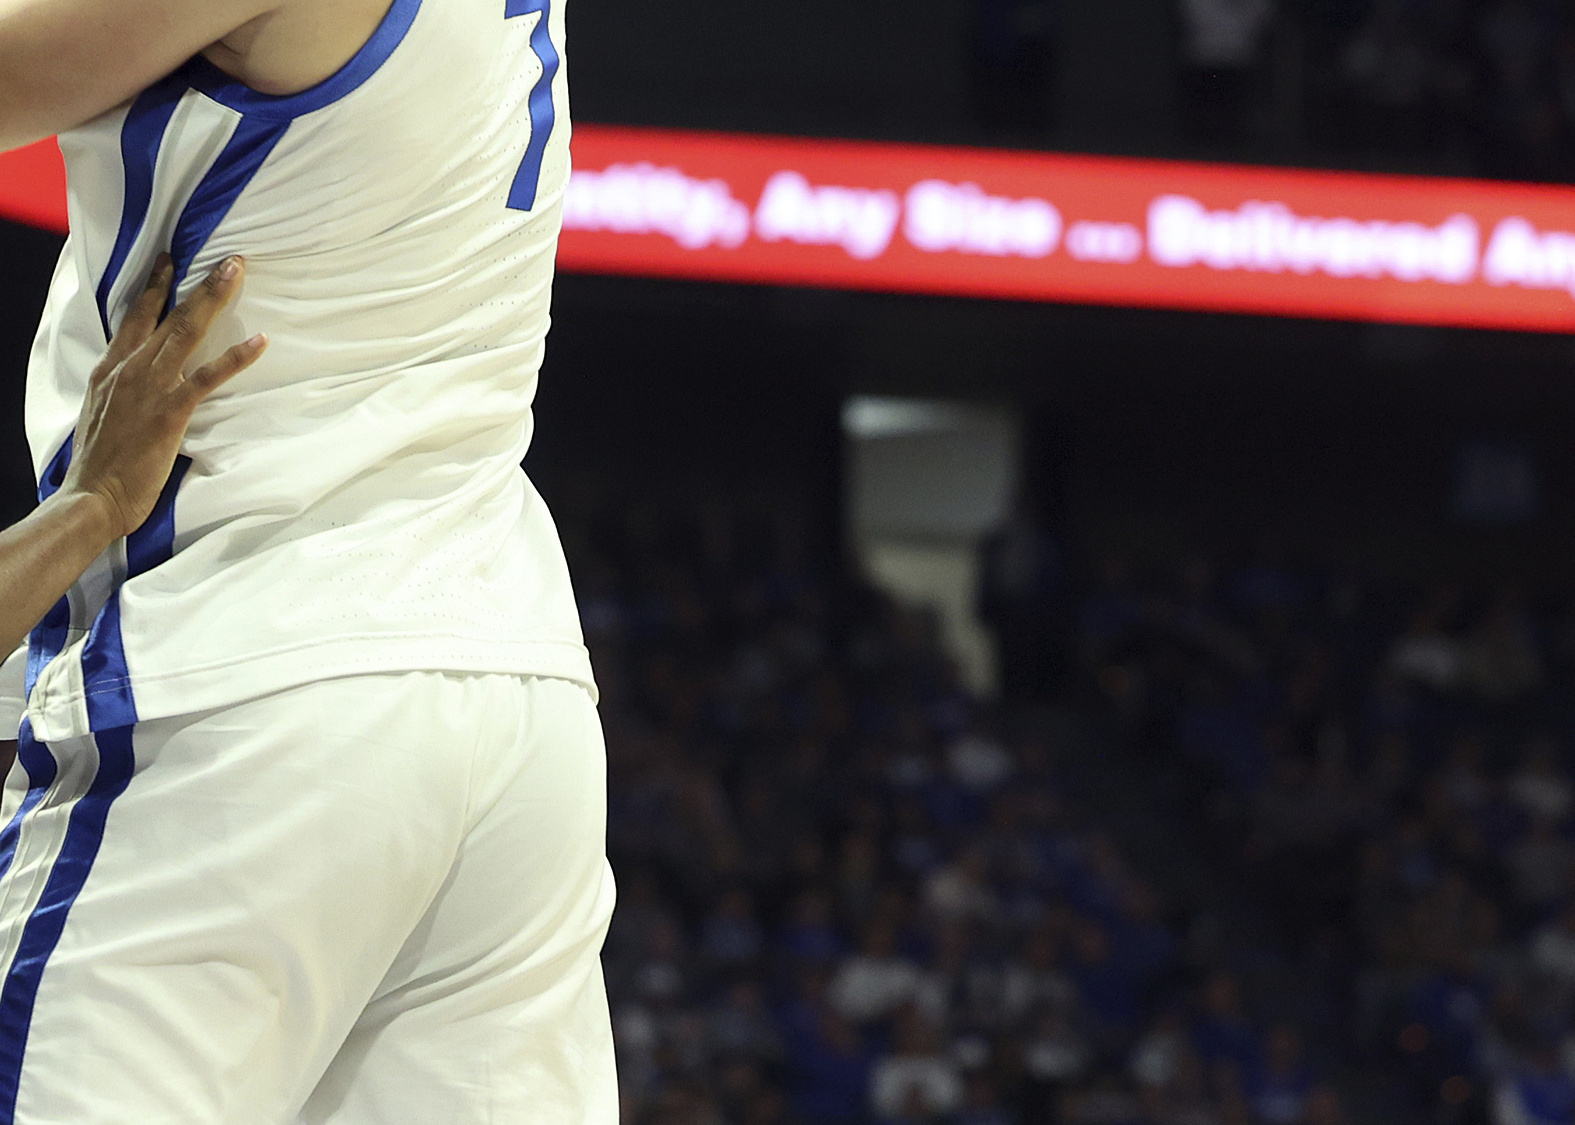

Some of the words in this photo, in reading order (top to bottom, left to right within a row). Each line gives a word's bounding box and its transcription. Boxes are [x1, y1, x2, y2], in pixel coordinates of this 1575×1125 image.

[753, 170, 900, 259] Any
[904, 179, 1062, 258] Size
[1146, 194, 1480, 284] Delivered
